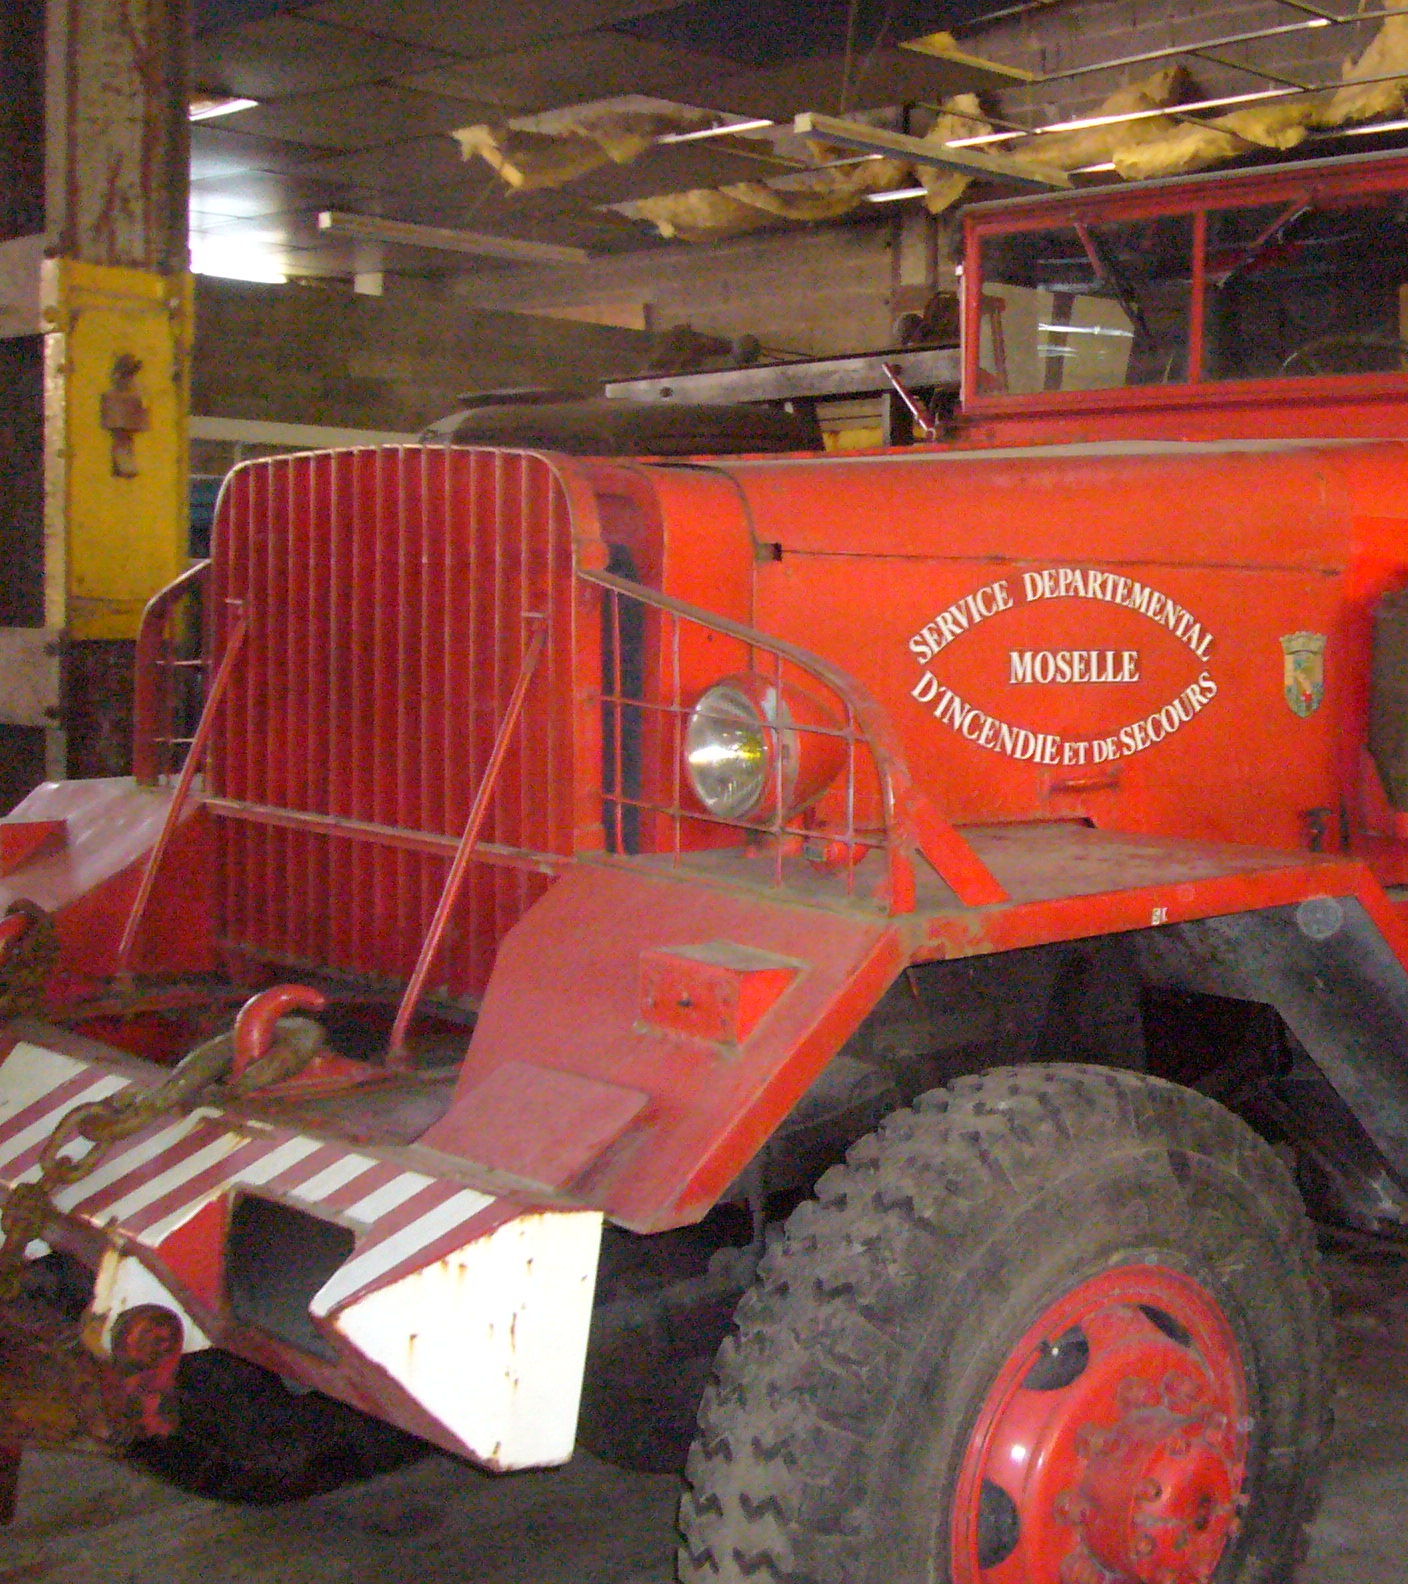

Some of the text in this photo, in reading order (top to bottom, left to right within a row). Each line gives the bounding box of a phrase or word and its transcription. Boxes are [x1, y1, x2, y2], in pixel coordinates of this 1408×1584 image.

[908, 568, 1215, 664] SERVICE DEPARTEMENTAL
[1009, 651, 1140, 684] MOSELLE
[911, 670, 1218, 765] D'INCENDIE ET DE SECOURS
